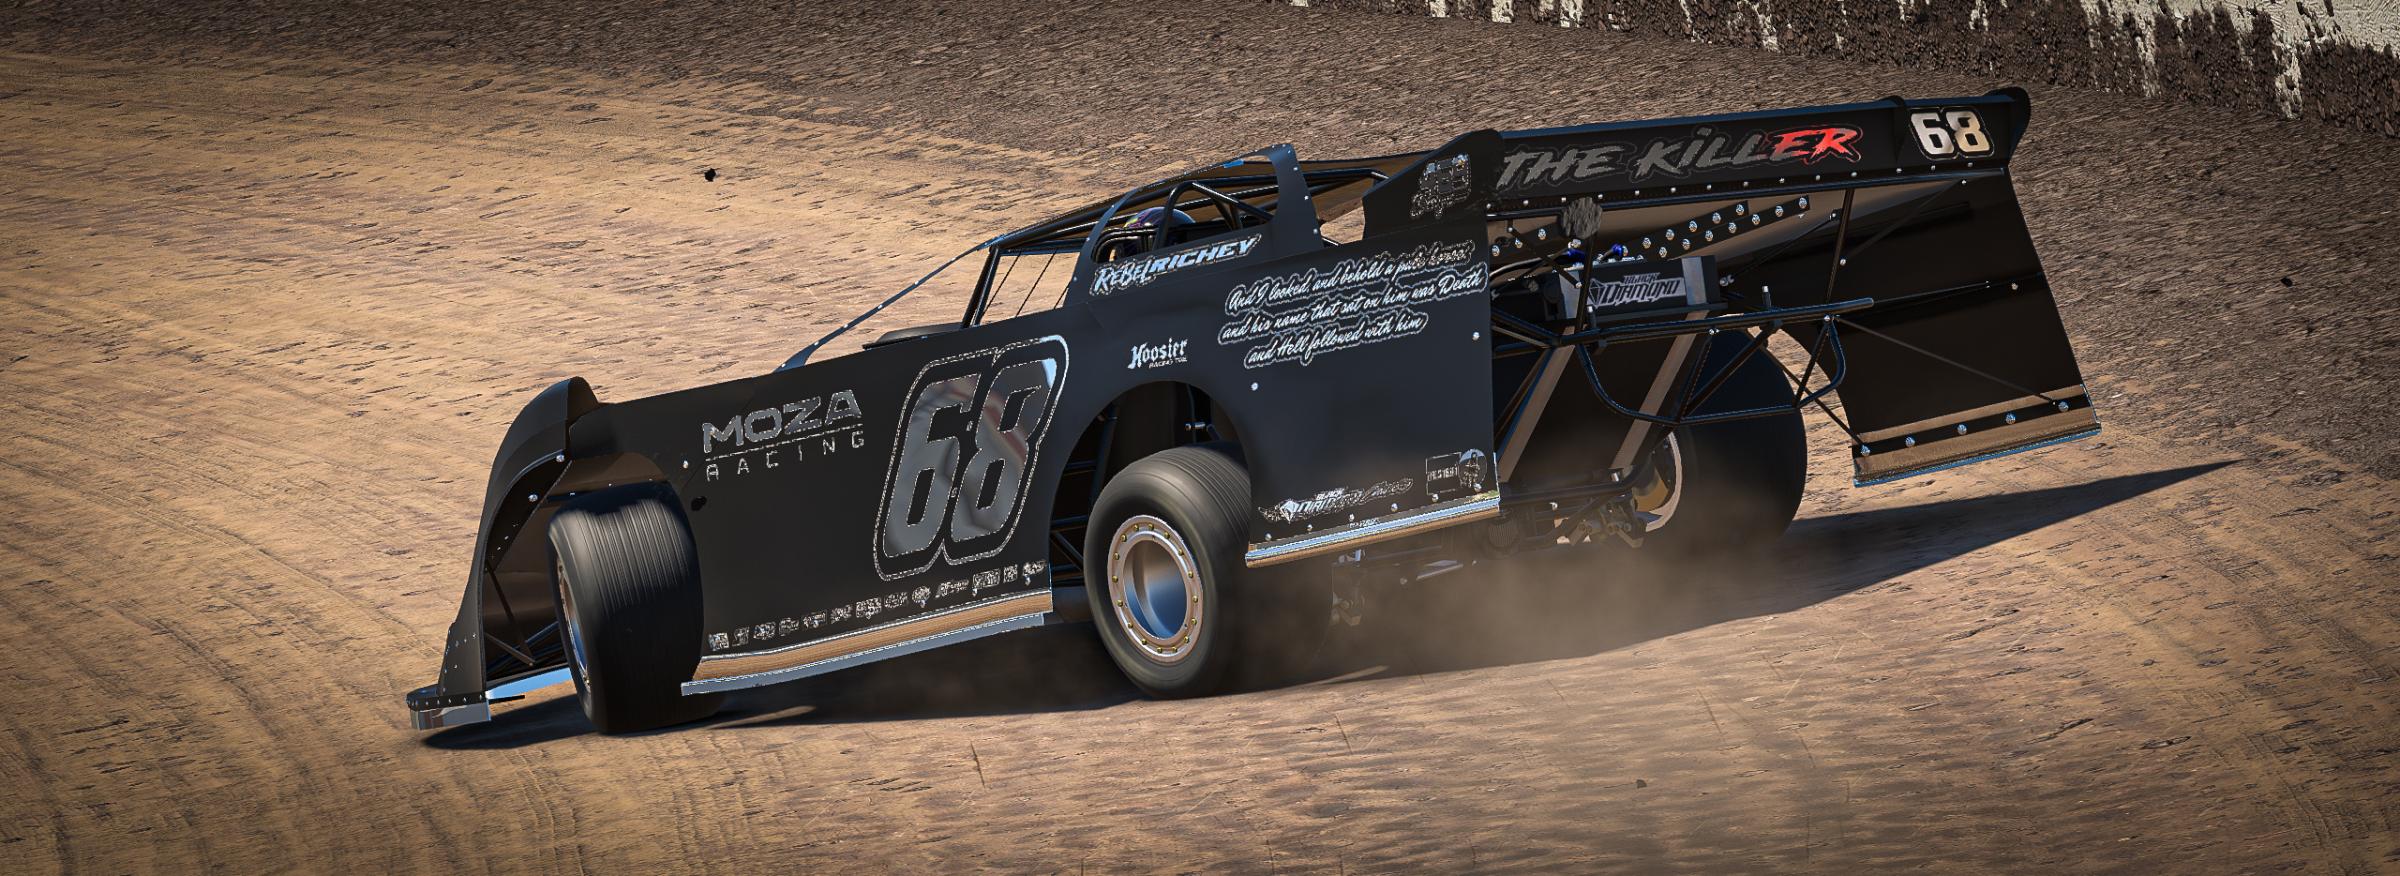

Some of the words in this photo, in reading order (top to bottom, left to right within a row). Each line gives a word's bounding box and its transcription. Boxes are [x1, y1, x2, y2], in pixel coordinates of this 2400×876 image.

[1910, 110, 1991, 155] 68
[1496, 144, 1625, 190] THE
[1221, 316, 1252, 339] and
[1250, 314, 1271, 334] his
[1273, 310, 1309, 328] name
[1310, 302, 1342, 321] that
[1340, 295, 1366, 314] sat
[1363, 297, 1381, 309] on
[1383, 285, 1409, 306] him
[1411, 283, 1437, 299] was
[1438, 268, 1483, 295] Death
[1228, 285, 1258, 311] And
[1312, 266, 1343, 291] and
[1340, 260, 1386, 287] behold
[1384, 264, 1395, 275] a
[1127, 337, 1188, 369] Hoosier
[1248, 338, 1279, 364] and
[1277, 333, 1311, 358] Hell
[1304, 321, 1366, 361] followed
[1364, 315, 1395, 338] with
[1394, 312, 1423, 333] him
[702, 389, 863, 453] MOZA
[706, 430, 865, 482] RACING
[880, 350, 1060, 562] 68
